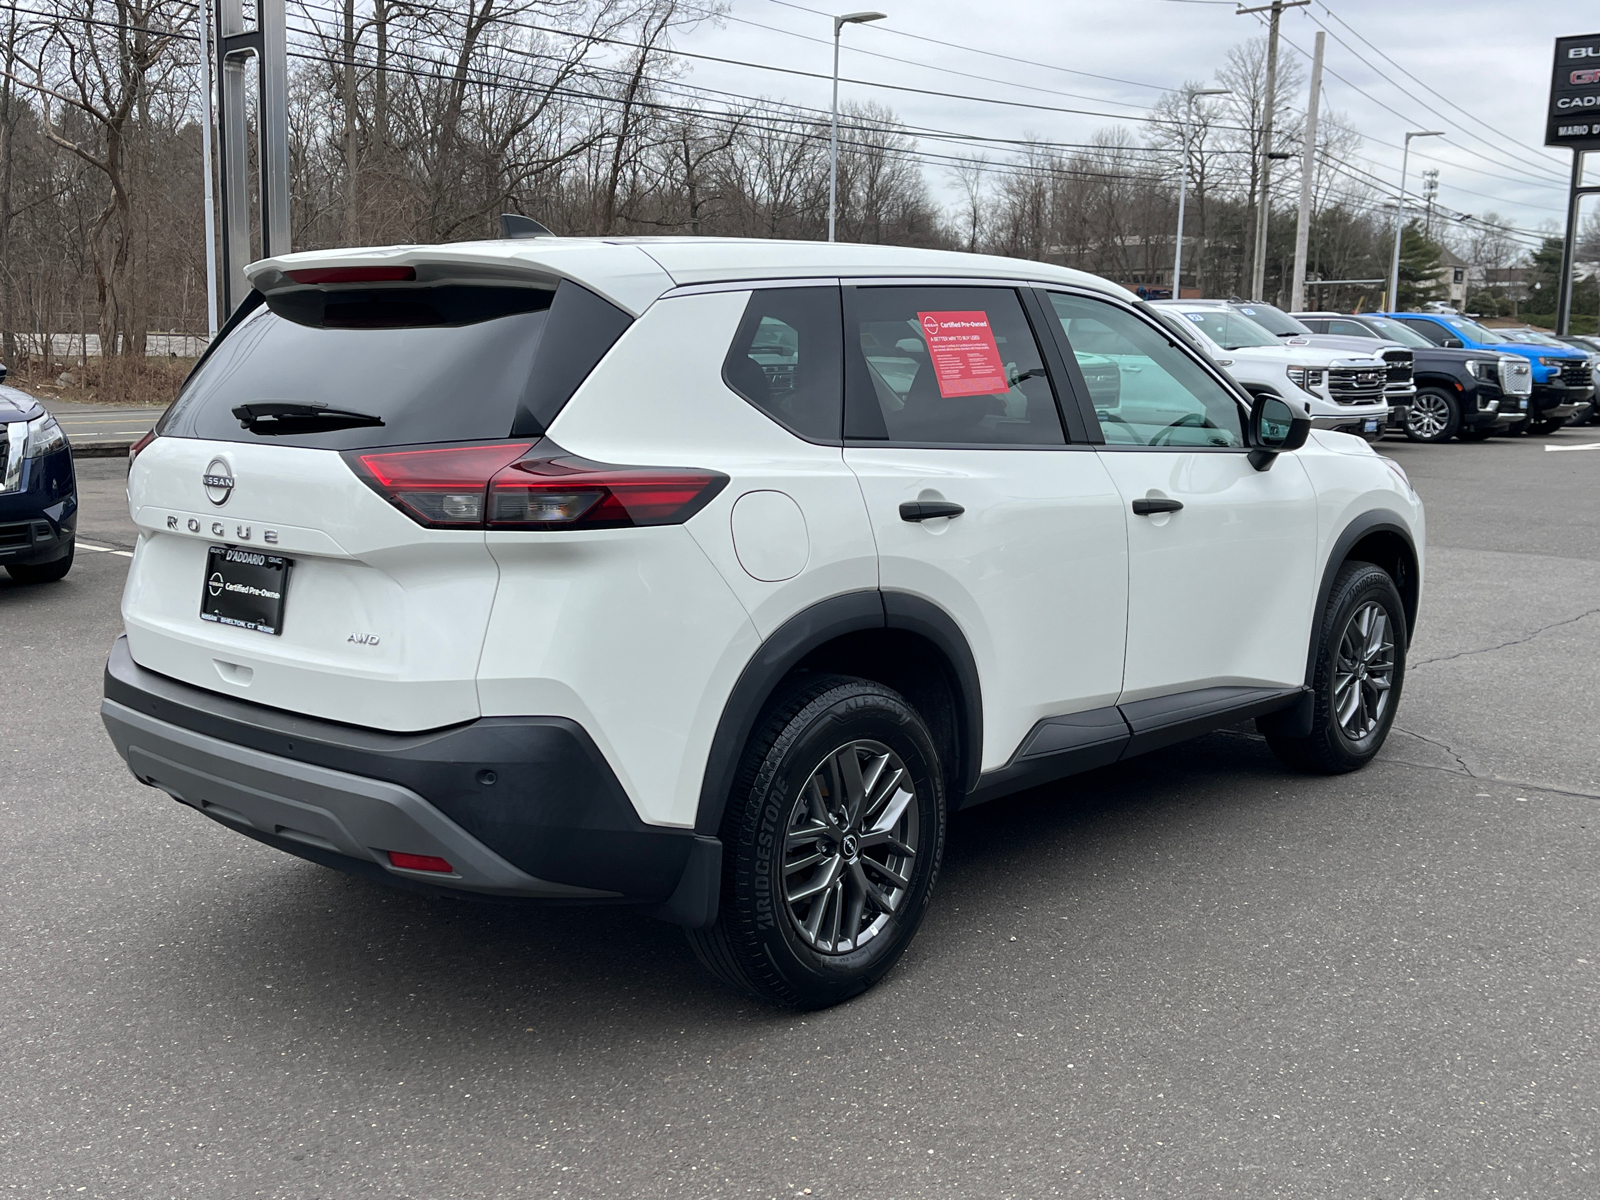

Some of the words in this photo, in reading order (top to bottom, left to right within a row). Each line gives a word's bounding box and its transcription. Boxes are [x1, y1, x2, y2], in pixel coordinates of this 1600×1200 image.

[1558, 125, 1588, 136] MARIO
[940, 321, 960, 329] Certified
[960, 320, 988, 328] Pre-Owned
[166, 515, 278, 544] ROGUE
[225, 549, 265, 566] D'ADDARIO
[225, 582, 249, 594] Certified
[347, 632, 380, 646] AWD
[755, 776, 790, 931] BRIDGESTONE
